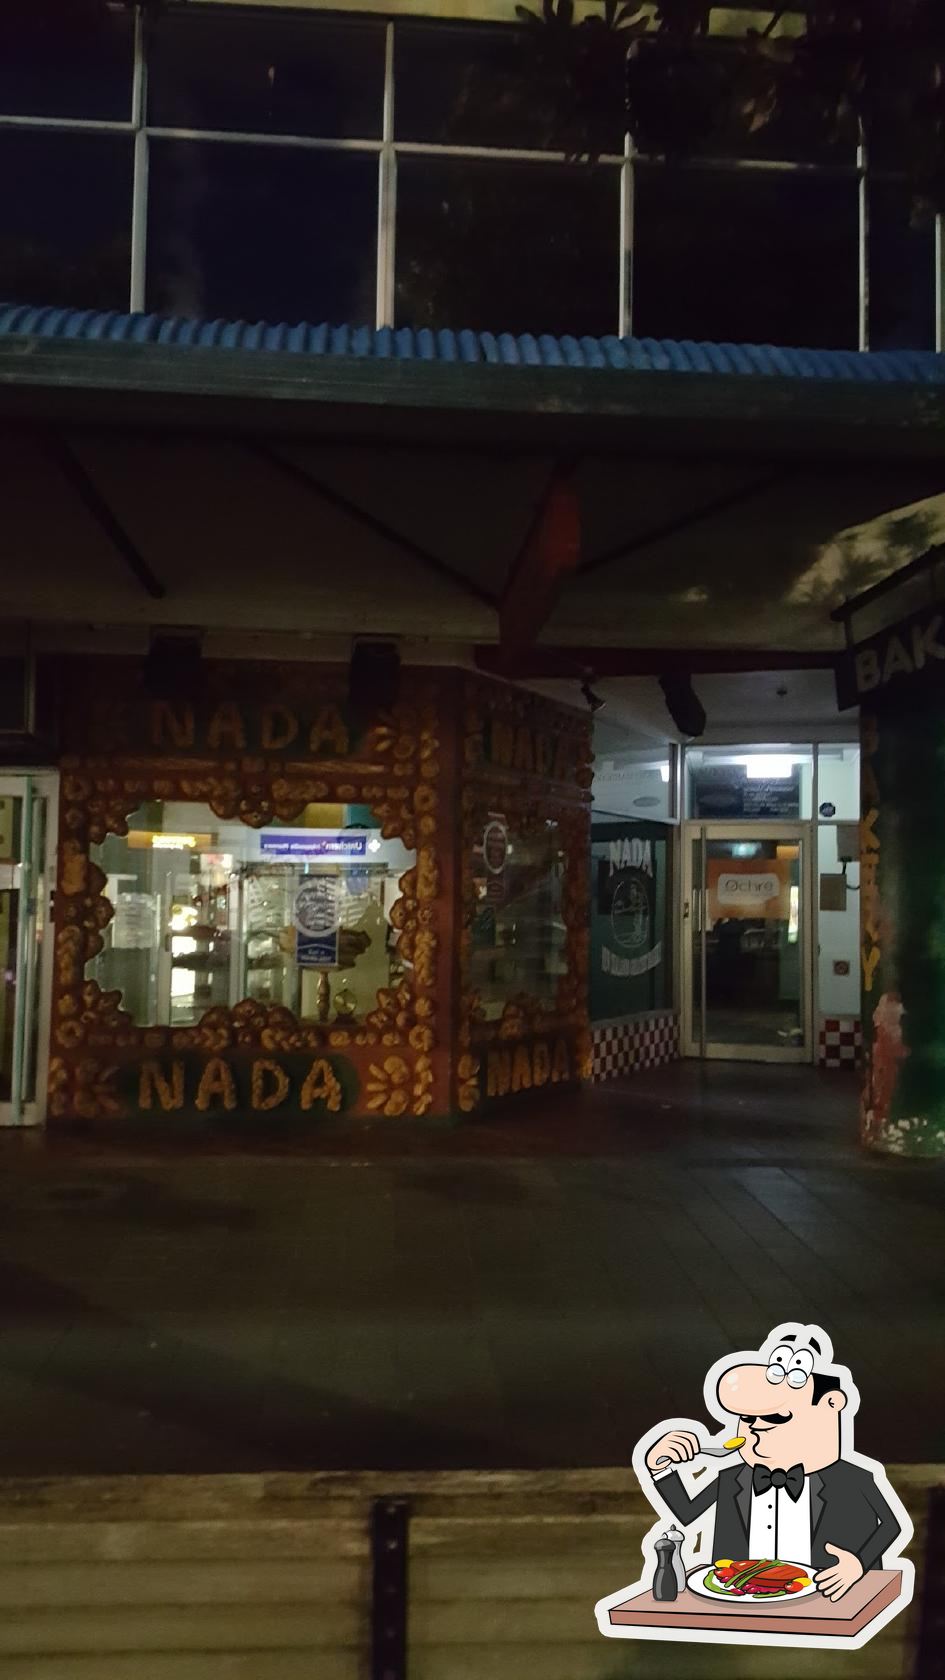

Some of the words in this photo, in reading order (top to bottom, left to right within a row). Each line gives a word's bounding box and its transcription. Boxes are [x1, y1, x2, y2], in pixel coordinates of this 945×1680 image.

[855, 615, 945, 693] BAK
[153, 700, 349, 754] NADA
[609, 838, 654, 878] NADA
[137, 1057, 342, 1112] NADA
[487, 1040, 570, 1097] NADA
